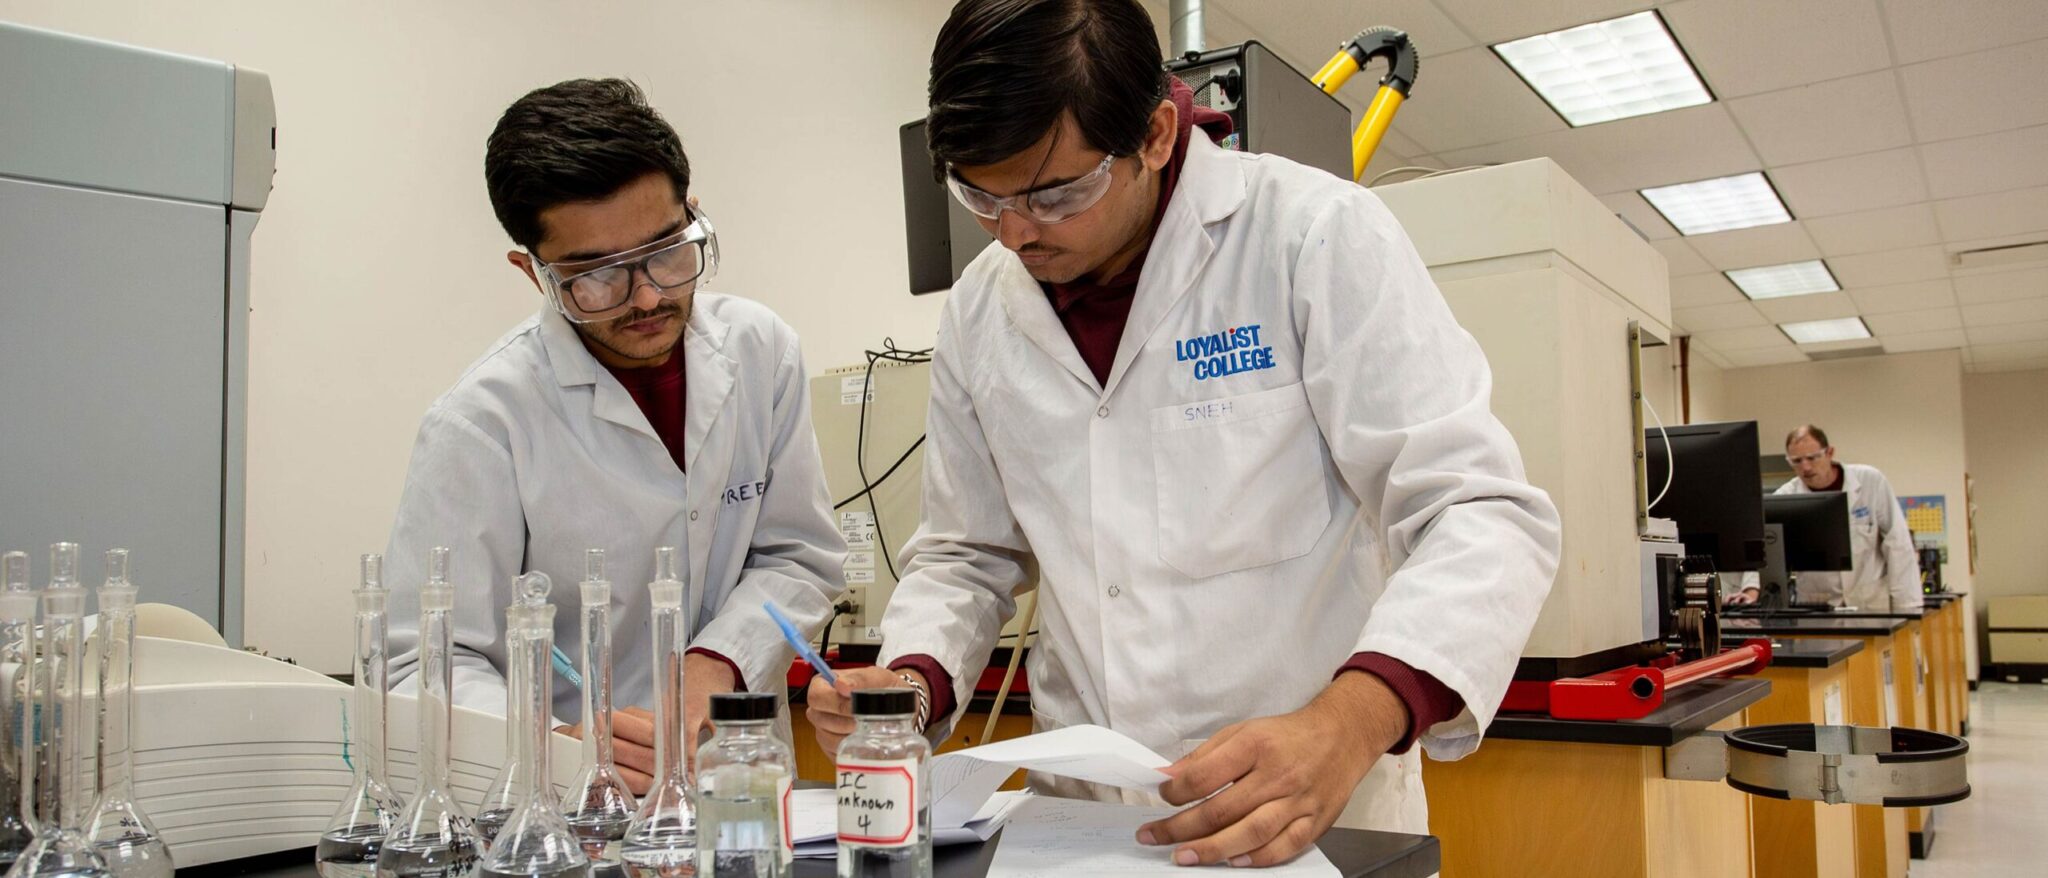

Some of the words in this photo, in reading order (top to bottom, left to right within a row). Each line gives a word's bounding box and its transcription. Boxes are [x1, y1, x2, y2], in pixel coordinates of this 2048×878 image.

[1194, 346, 1276, 381] COLLEGE
[1184, 401, 1233, 421] SNEH
[721, 482, 764, 504] REE
[839, 771, 867, 789] IC
[857, 813, 872, 836] 4
